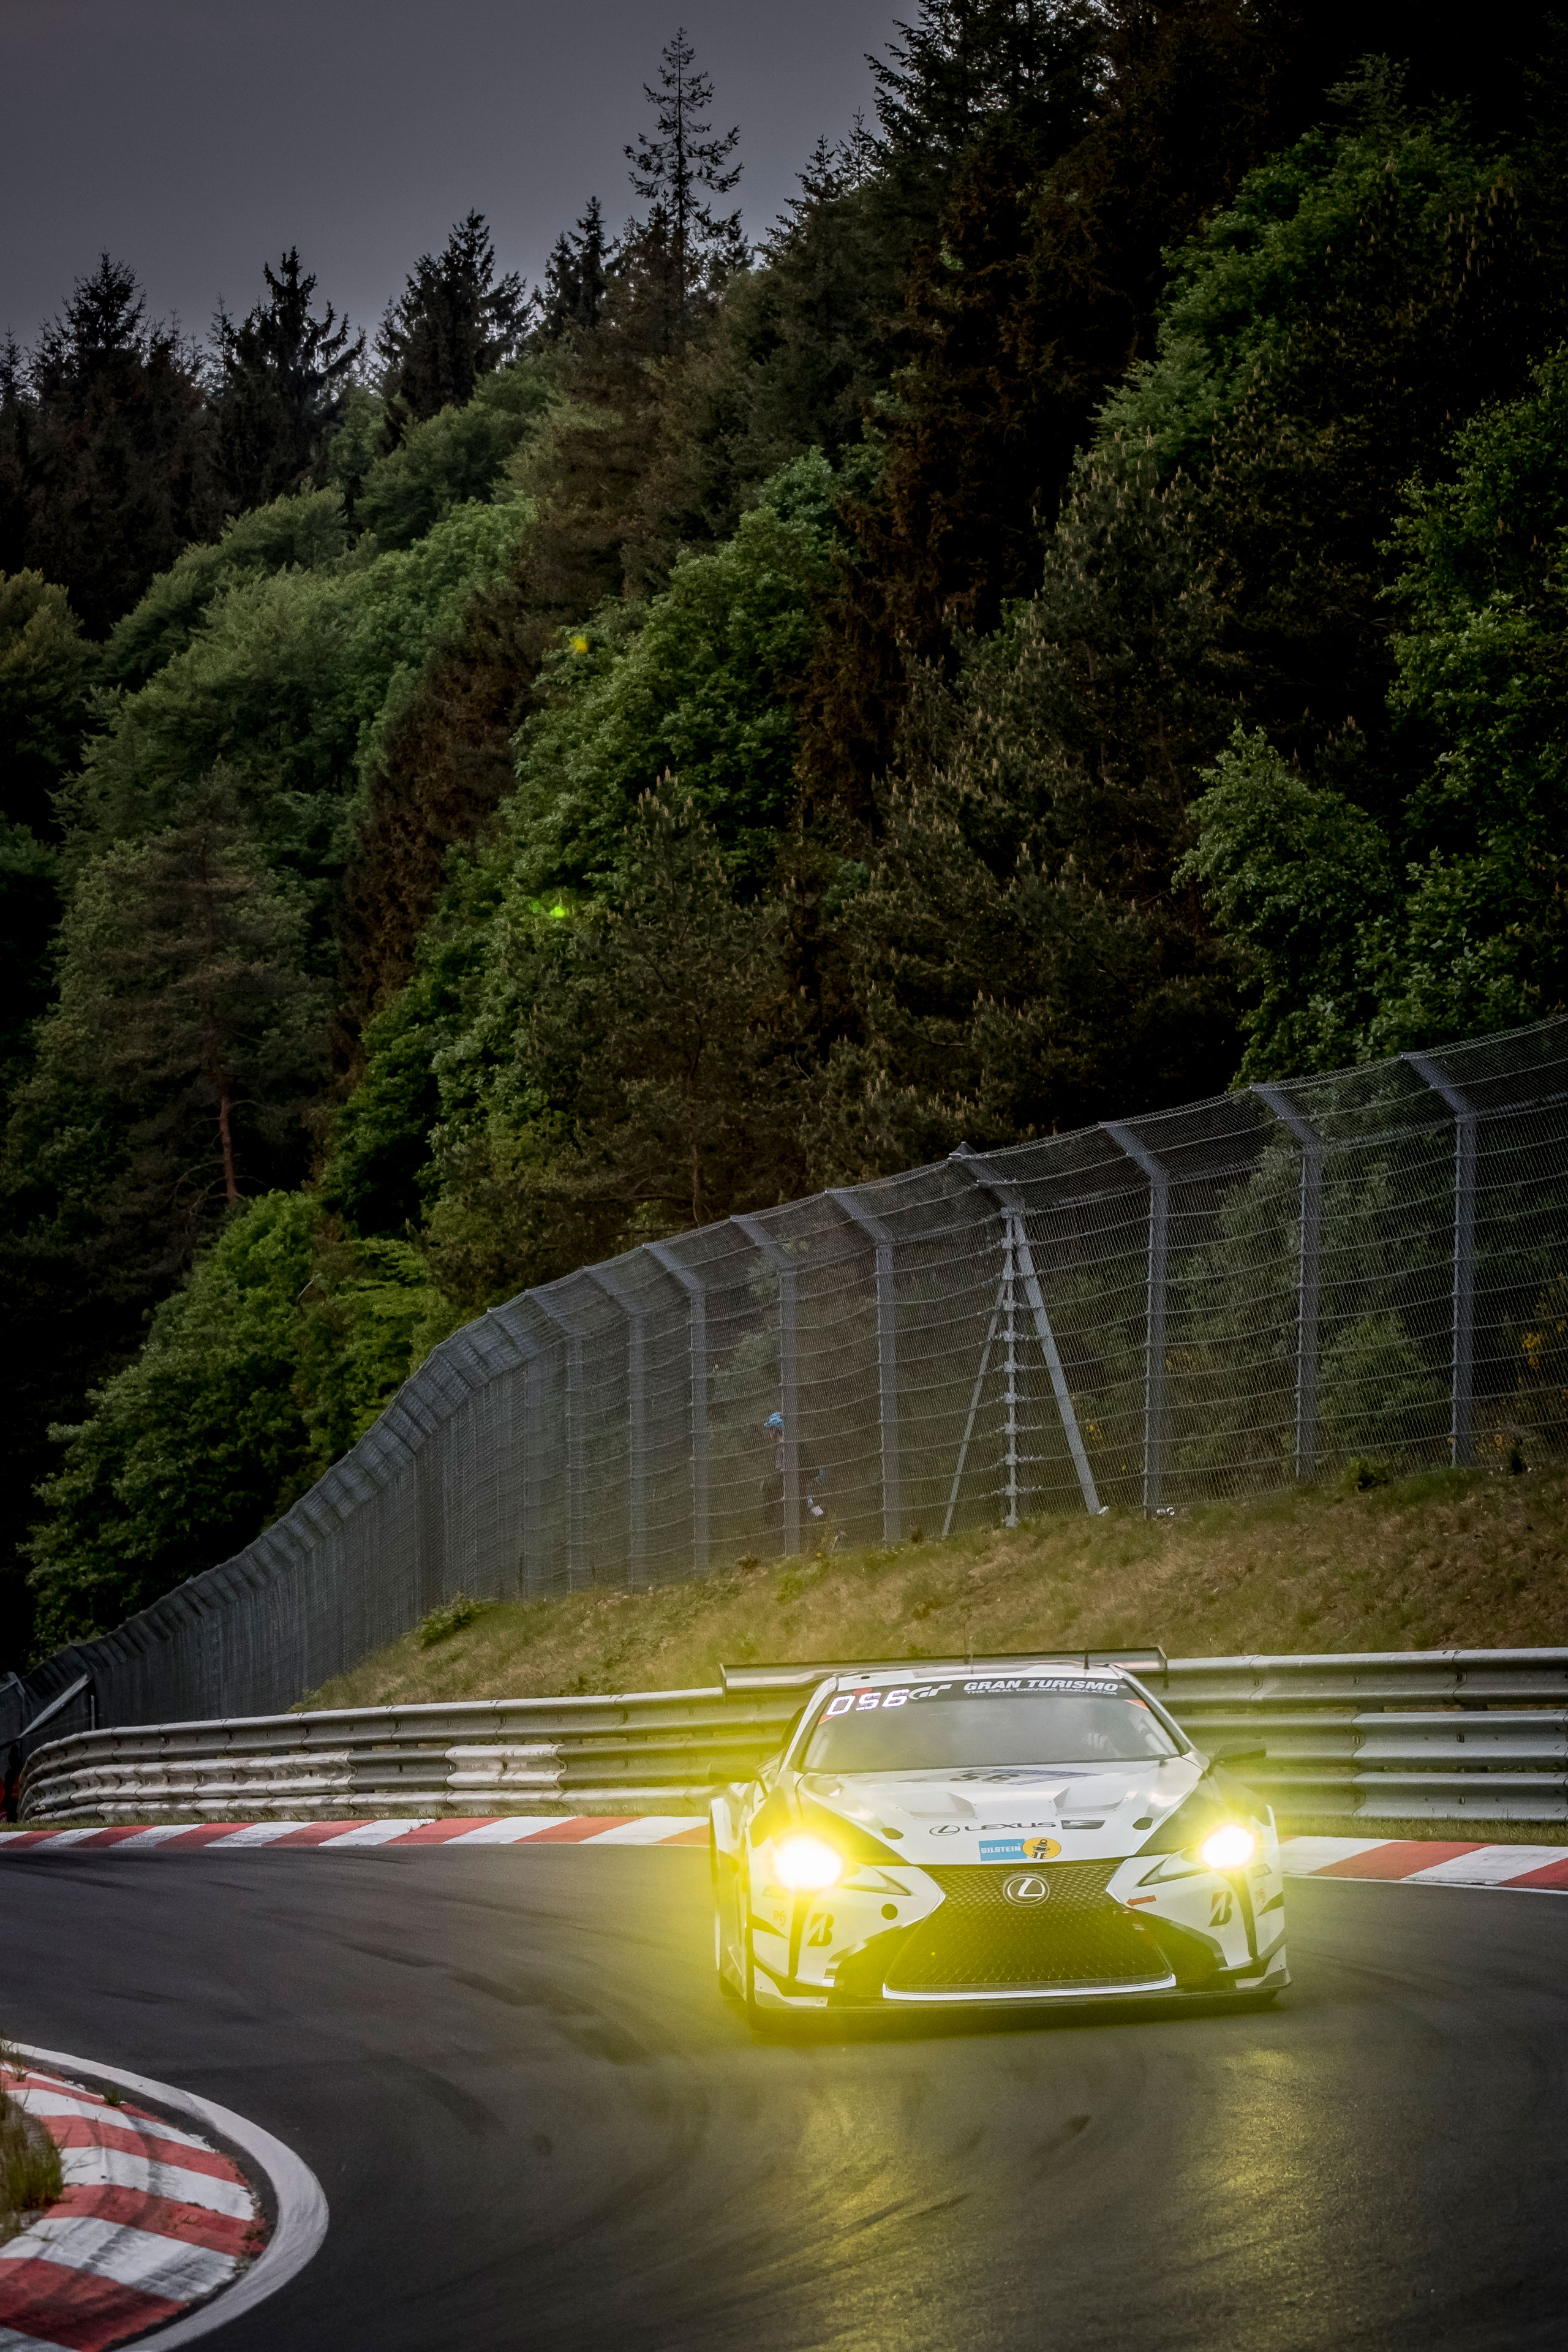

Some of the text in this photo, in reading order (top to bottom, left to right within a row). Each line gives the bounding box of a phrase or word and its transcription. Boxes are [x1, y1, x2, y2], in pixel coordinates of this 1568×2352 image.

[963, 1679, 1118, 1691] GRAN TURISMO
[826, 1689, 910, 1716] 056
[949, 1773, 1020, 1782] 56
[965, 1822, 1057, 1831] LEXUS
[981, 1844, 1022, 1854] BILSTEIN
